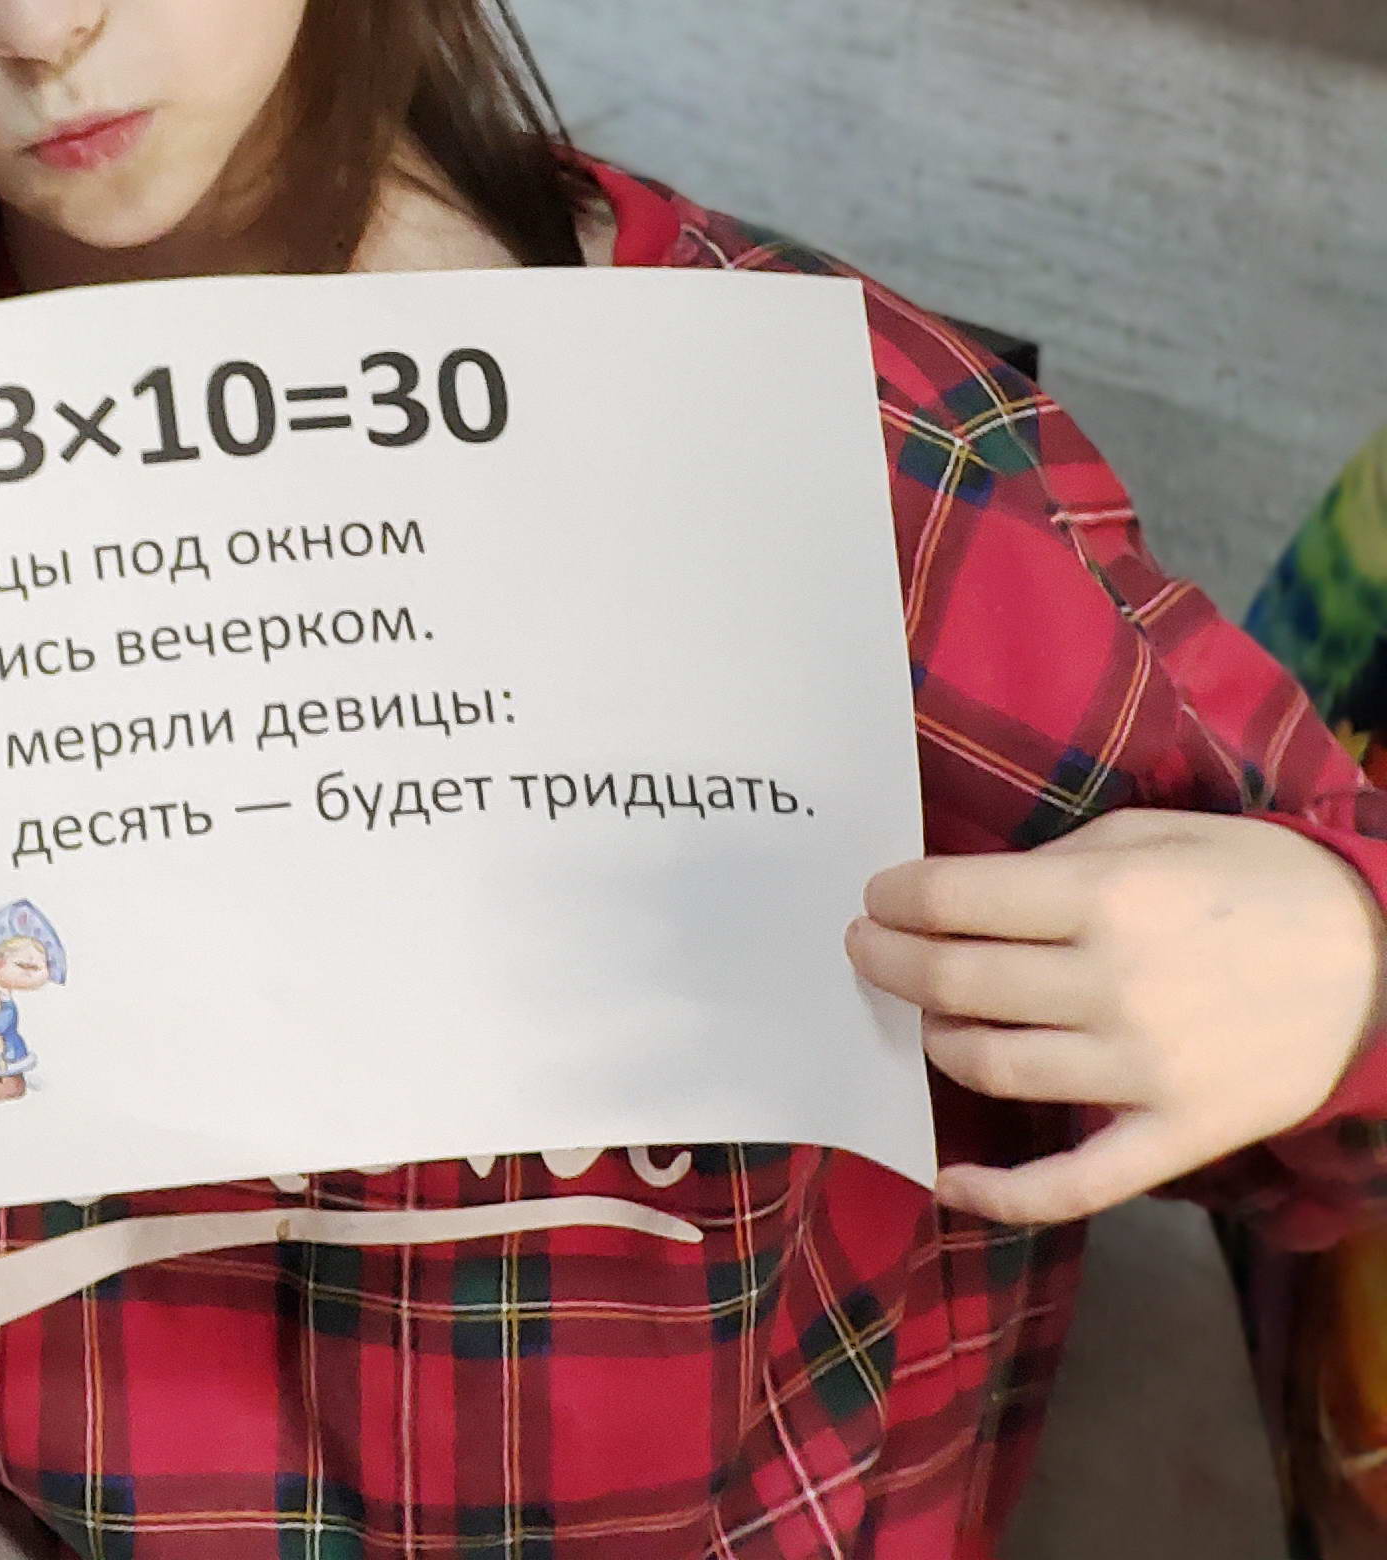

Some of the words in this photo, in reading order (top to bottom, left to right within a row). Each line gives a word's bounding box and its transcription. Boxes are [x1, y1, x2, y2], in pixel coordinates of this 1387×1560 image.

[92, 534, 212, 586] под
[225, 518, 427, 566] окном
[115, 605, 435, 668] вечерком.
[5, 706, 236, 773] меряли
[255, 688, 517, 753] девицы:
[10, 799, 215, 870] десять
[314, 768, 495, 833] будет
[508, 771, 816, 822] тридцать.
